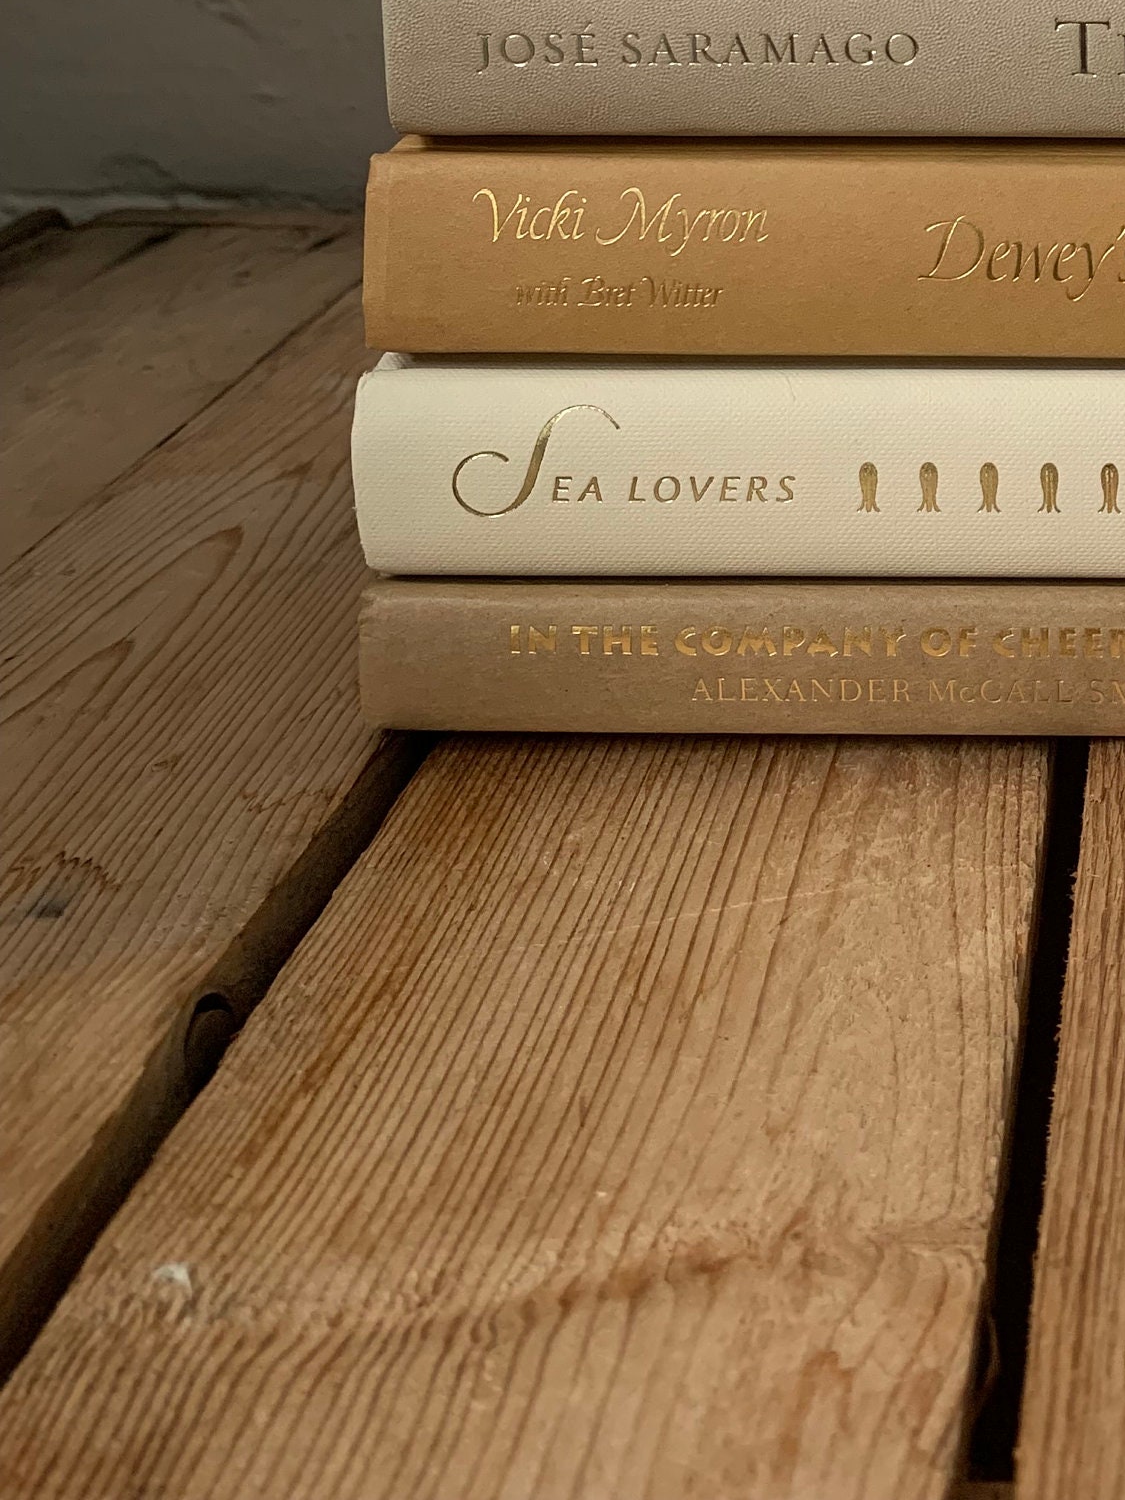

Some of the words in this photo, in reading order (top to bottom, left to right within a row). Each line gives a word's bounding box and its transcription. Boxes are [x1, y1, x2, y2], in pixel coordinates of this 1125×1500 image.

[475, 22, 600, 75] JOSÉ
[620, 32, 921, 68] SARAMAGO
[472, 188, 588, 243] Vicki
[595, 187, 770, 257] Myron
[515, 276, 572, 307] with
[577, 276, 637, 307] Bret
[640, 276, 725, 308] Witter
[452, 403, 621, 518] SEA
[627, 475, 797, 504] LOVERS
[510, 624, 558, 656] IN
[571, 624, 660, 657] THE
[674, 625, 908, 659] COMPANY
[919, 625, 979, 659] OF
[692, 676, 911, 703] ALEXANDER
[927, 678, 1075, 705] McCALL
